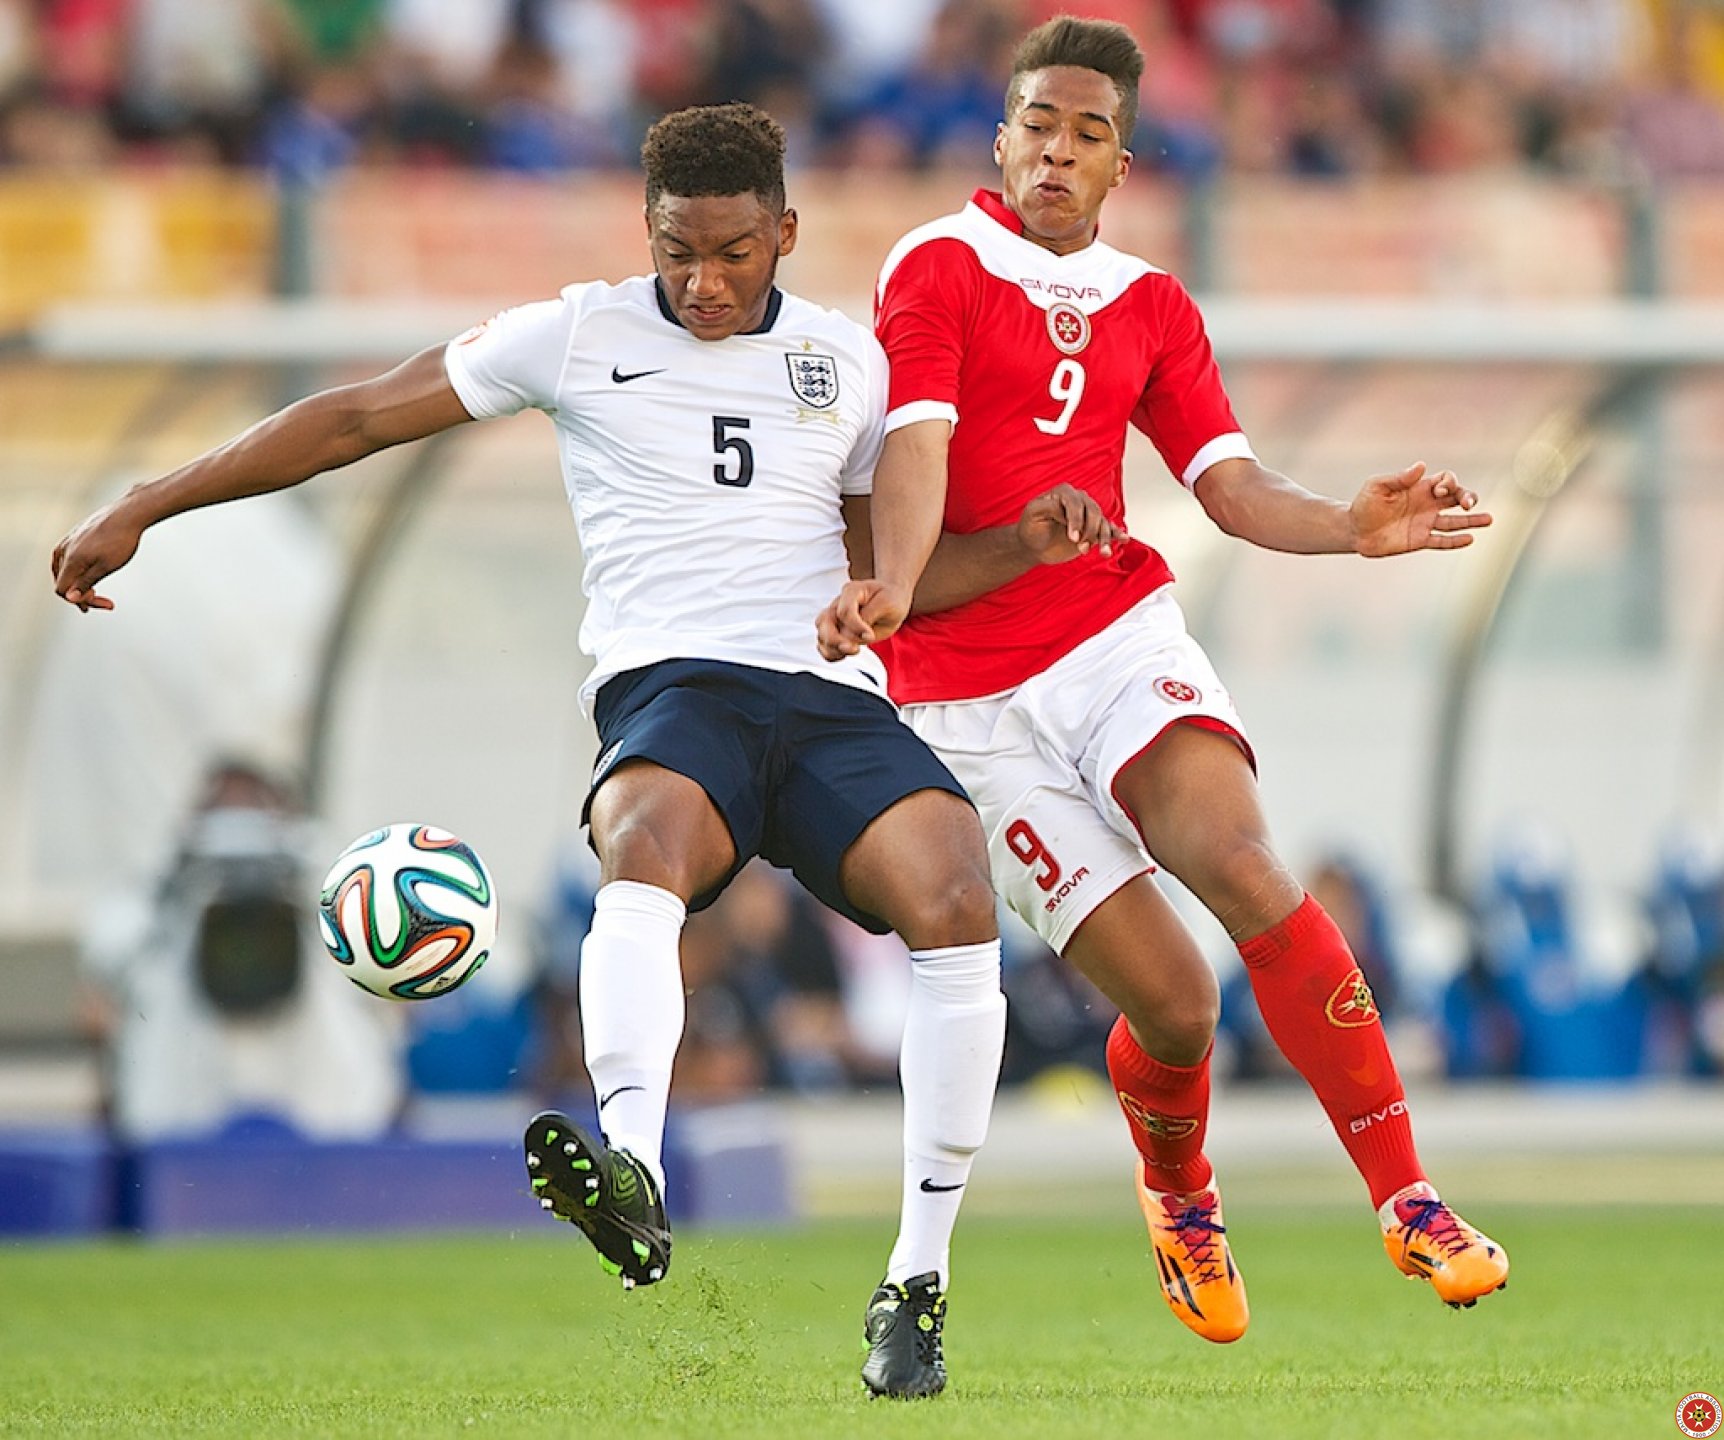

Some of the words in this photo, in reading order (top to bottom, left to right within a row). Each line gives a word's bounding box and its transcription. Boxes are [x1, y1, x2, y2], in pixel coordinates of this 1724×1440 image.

[1019, 278, 1103, 301] GIVOVA
[1032, 358, 1086, 435] 9
[712, 415, 753, 488] 5
[1005, 819, 1061, 891] 9
[1045, 866, 1090, 913] GIVOVA
